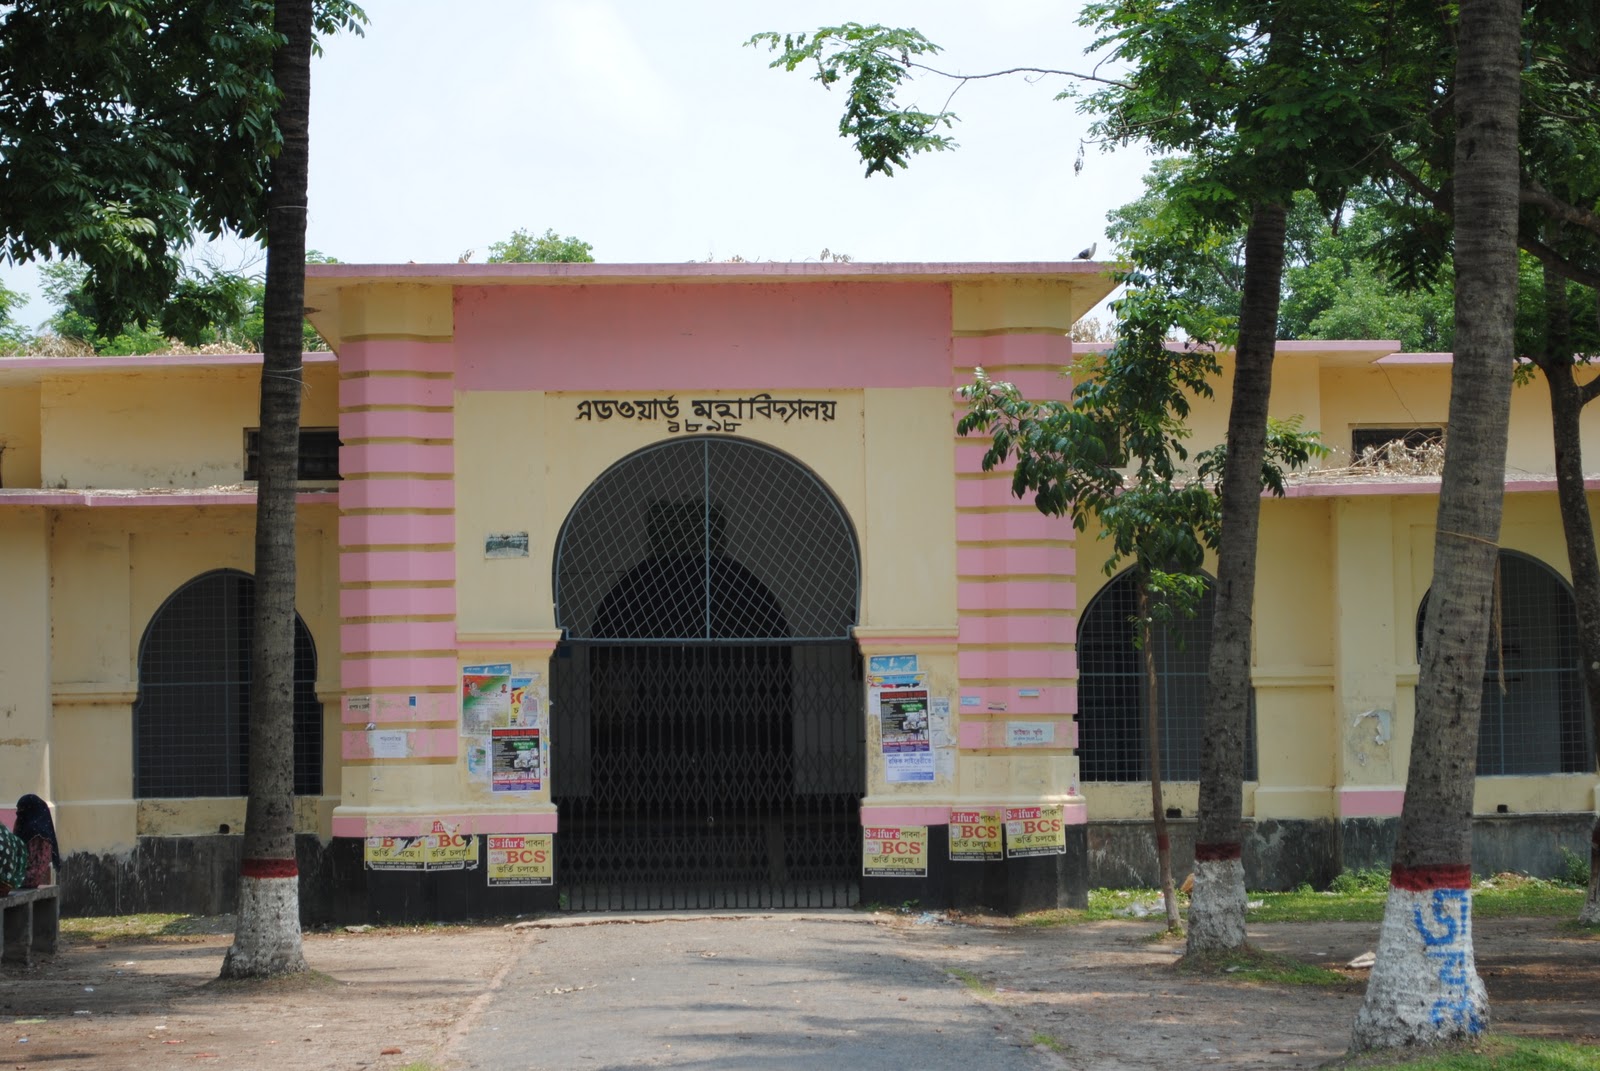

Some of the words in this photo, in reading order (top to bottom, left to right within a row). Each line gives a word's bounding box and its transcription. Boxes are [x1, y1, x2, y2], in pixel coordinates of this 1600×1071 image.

[667, 419, 742, 433] ১৮৯৮
[961, 825, 997, 839] BCS
[1023, 819, 1061, 834] BCS
[438, 834, 466, 848] BC
[881, 841, 921, 855] BCS
[506, 850, 546, 864] BCS
